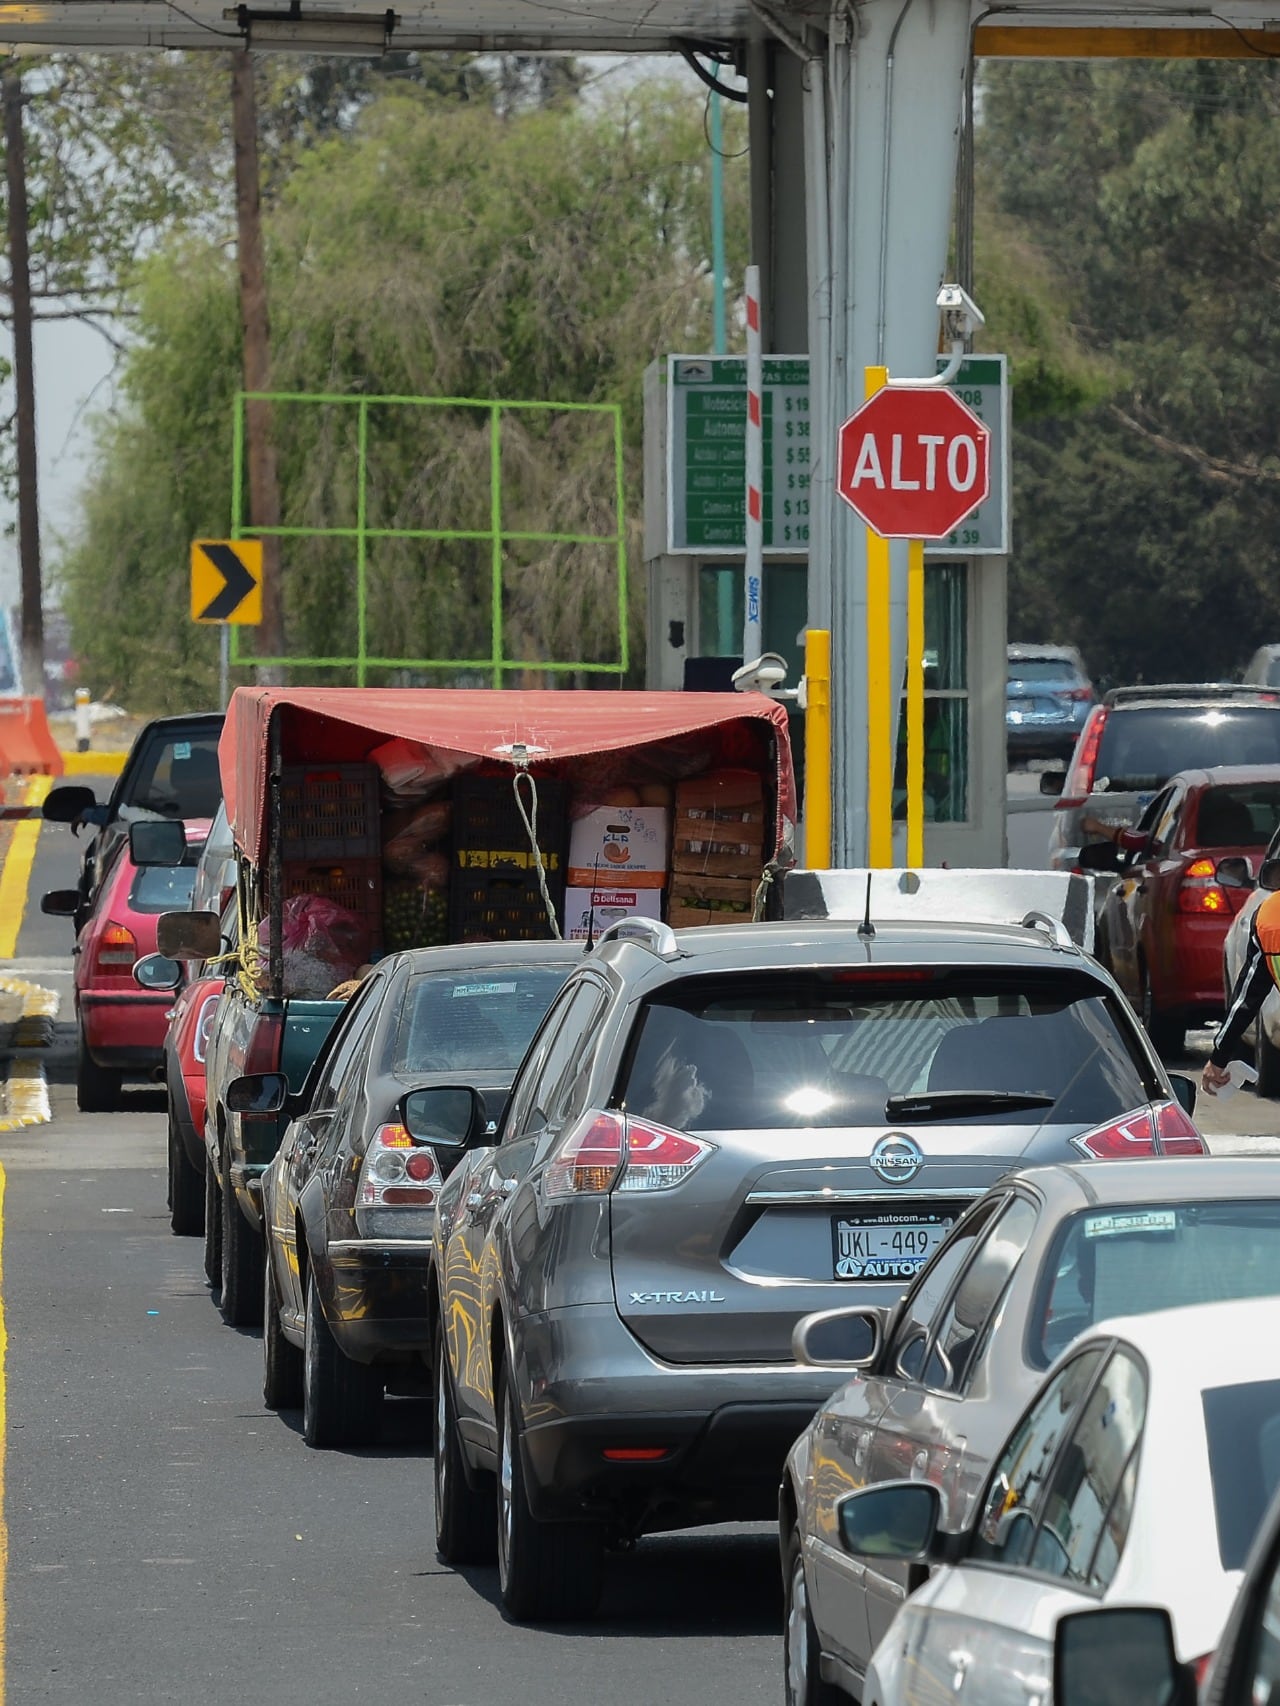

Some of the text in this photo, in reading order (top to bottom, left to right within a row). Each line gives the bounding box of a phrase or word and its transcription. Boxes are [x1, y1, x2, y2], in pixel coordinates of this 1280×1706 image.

[785, 397, 793, 412] $
[786, 421, 793, 437] $
[851, 433, 978, 493] ALTO
[796, 500, 809, 515] 13
[796, 525, 809, 540] 16
[962, 529, 980, 544] 39
[840, 1230, 949, 1258] UKL-449-
[863, 1262, 926, 1277] AUTOC
[629, 1290, 726, 1305] X-TRAIL
